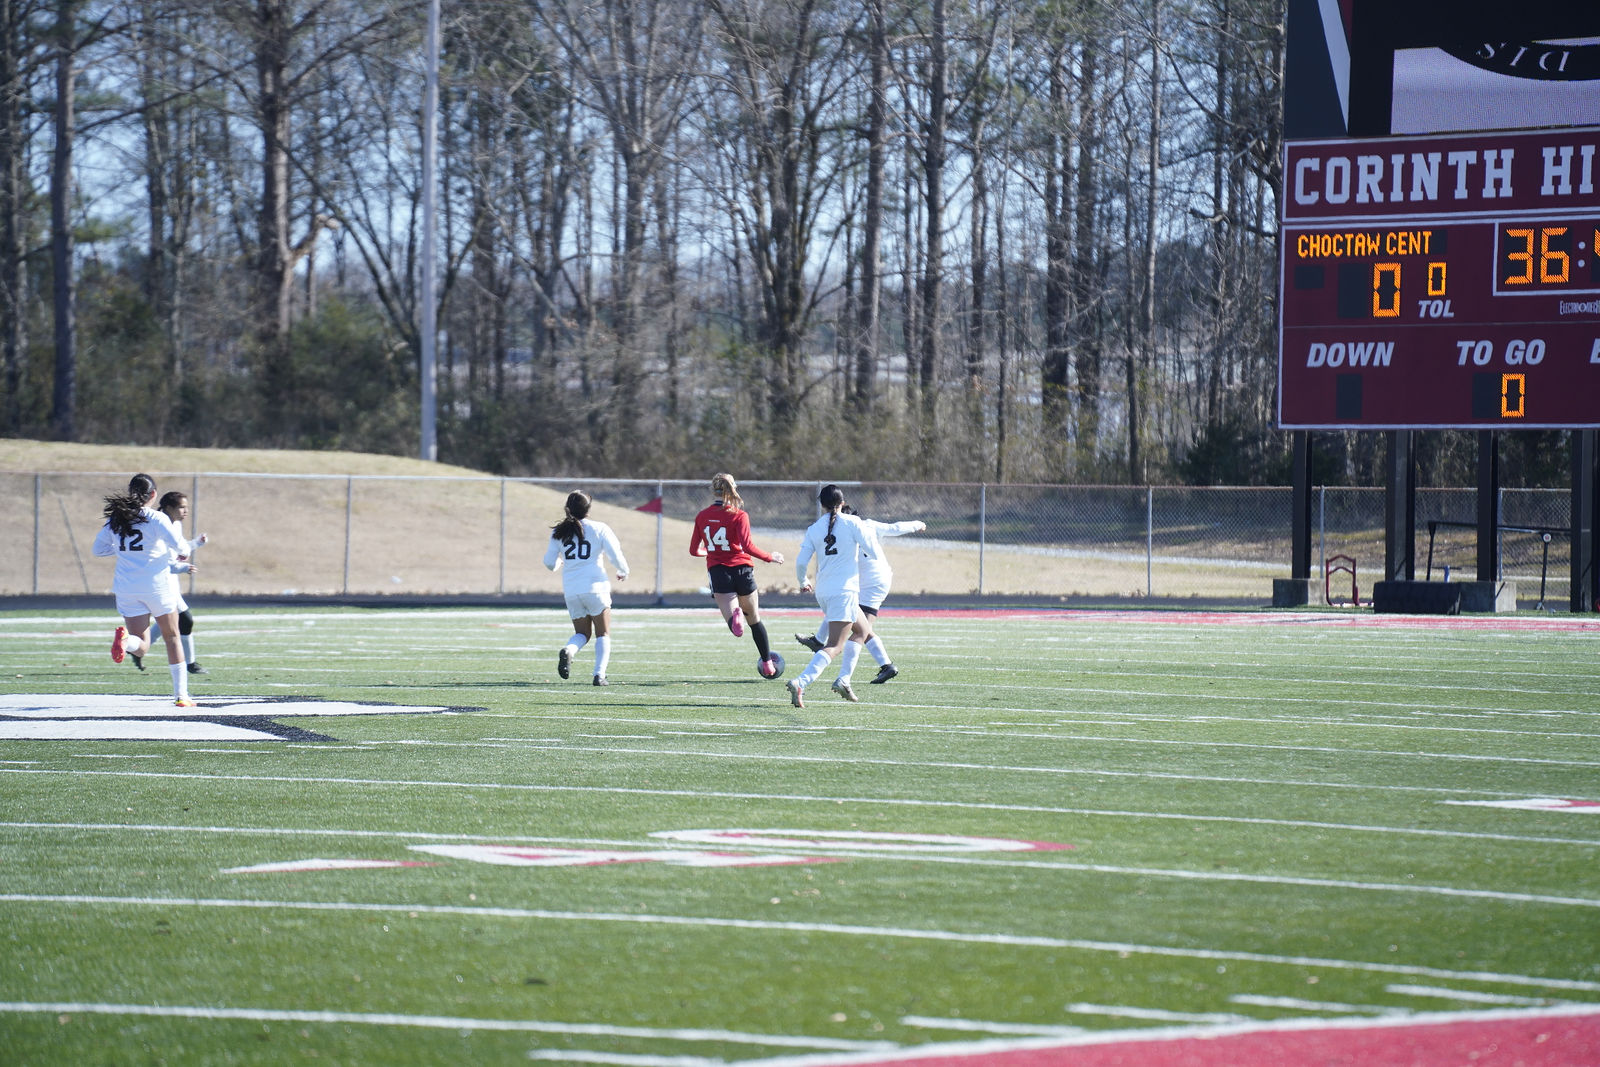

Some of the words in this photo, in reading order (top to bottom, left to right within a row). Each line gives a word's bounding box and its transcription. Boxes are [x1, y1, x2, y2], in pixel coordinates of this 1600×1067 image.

[1295, 148, 1514, 205] CORINTH
[1541, 145, 1596, 195] HI
[1298, 233, 1380, 258] CHOCTAW
[1386, 231, 1432, 255] CENT
[1373, 262, 1401, 317] 0
[1428, 262, 1447, 295] 0
[1418, 299, 1454, 318] TOL
[1306, 342, 1395, 367] DOWN
[1456, 340, 1493, 366] TO
[1504, 339, 1546, 365] GO
[1501, 373, 1525, 418] 0
[119, 528, 144, 552] 12
[563, 540, 592, 560] 20
[703, 525, 731, 552] 14
[823, 533, 838, 556] 2
